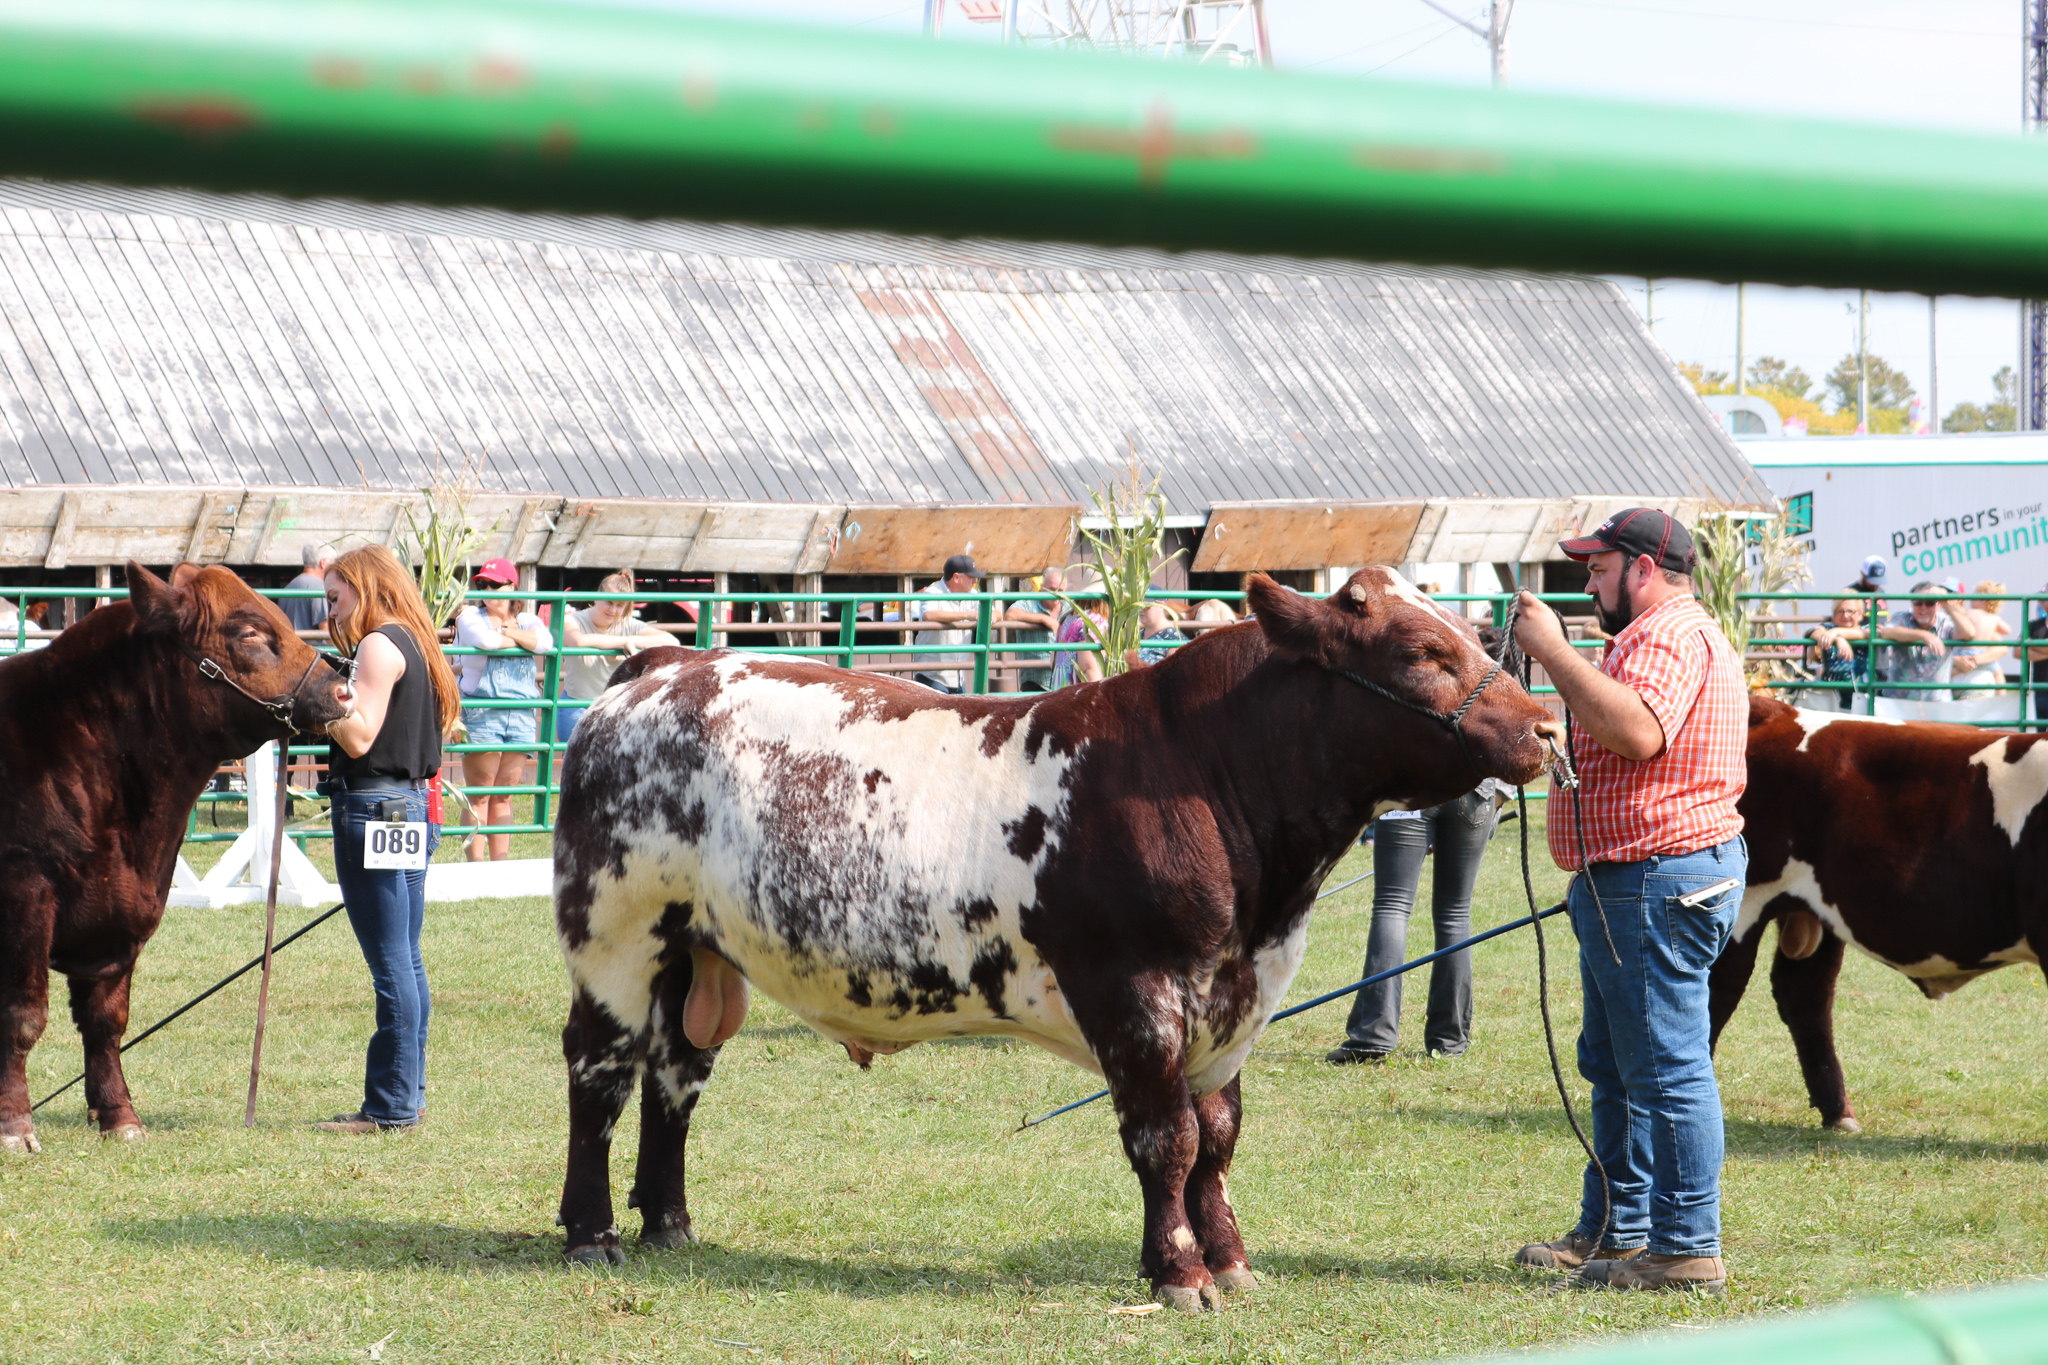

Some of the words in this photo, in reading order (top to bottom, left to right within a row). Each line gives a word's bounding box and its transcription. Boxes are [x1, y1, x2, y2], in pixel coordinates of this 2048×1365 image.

[1892, 508, 1999, 557] partners
[2003, 509, 2014, 520] in
[2017, 503, 2042, 519] your
[372, 829, 420, 854] 089
